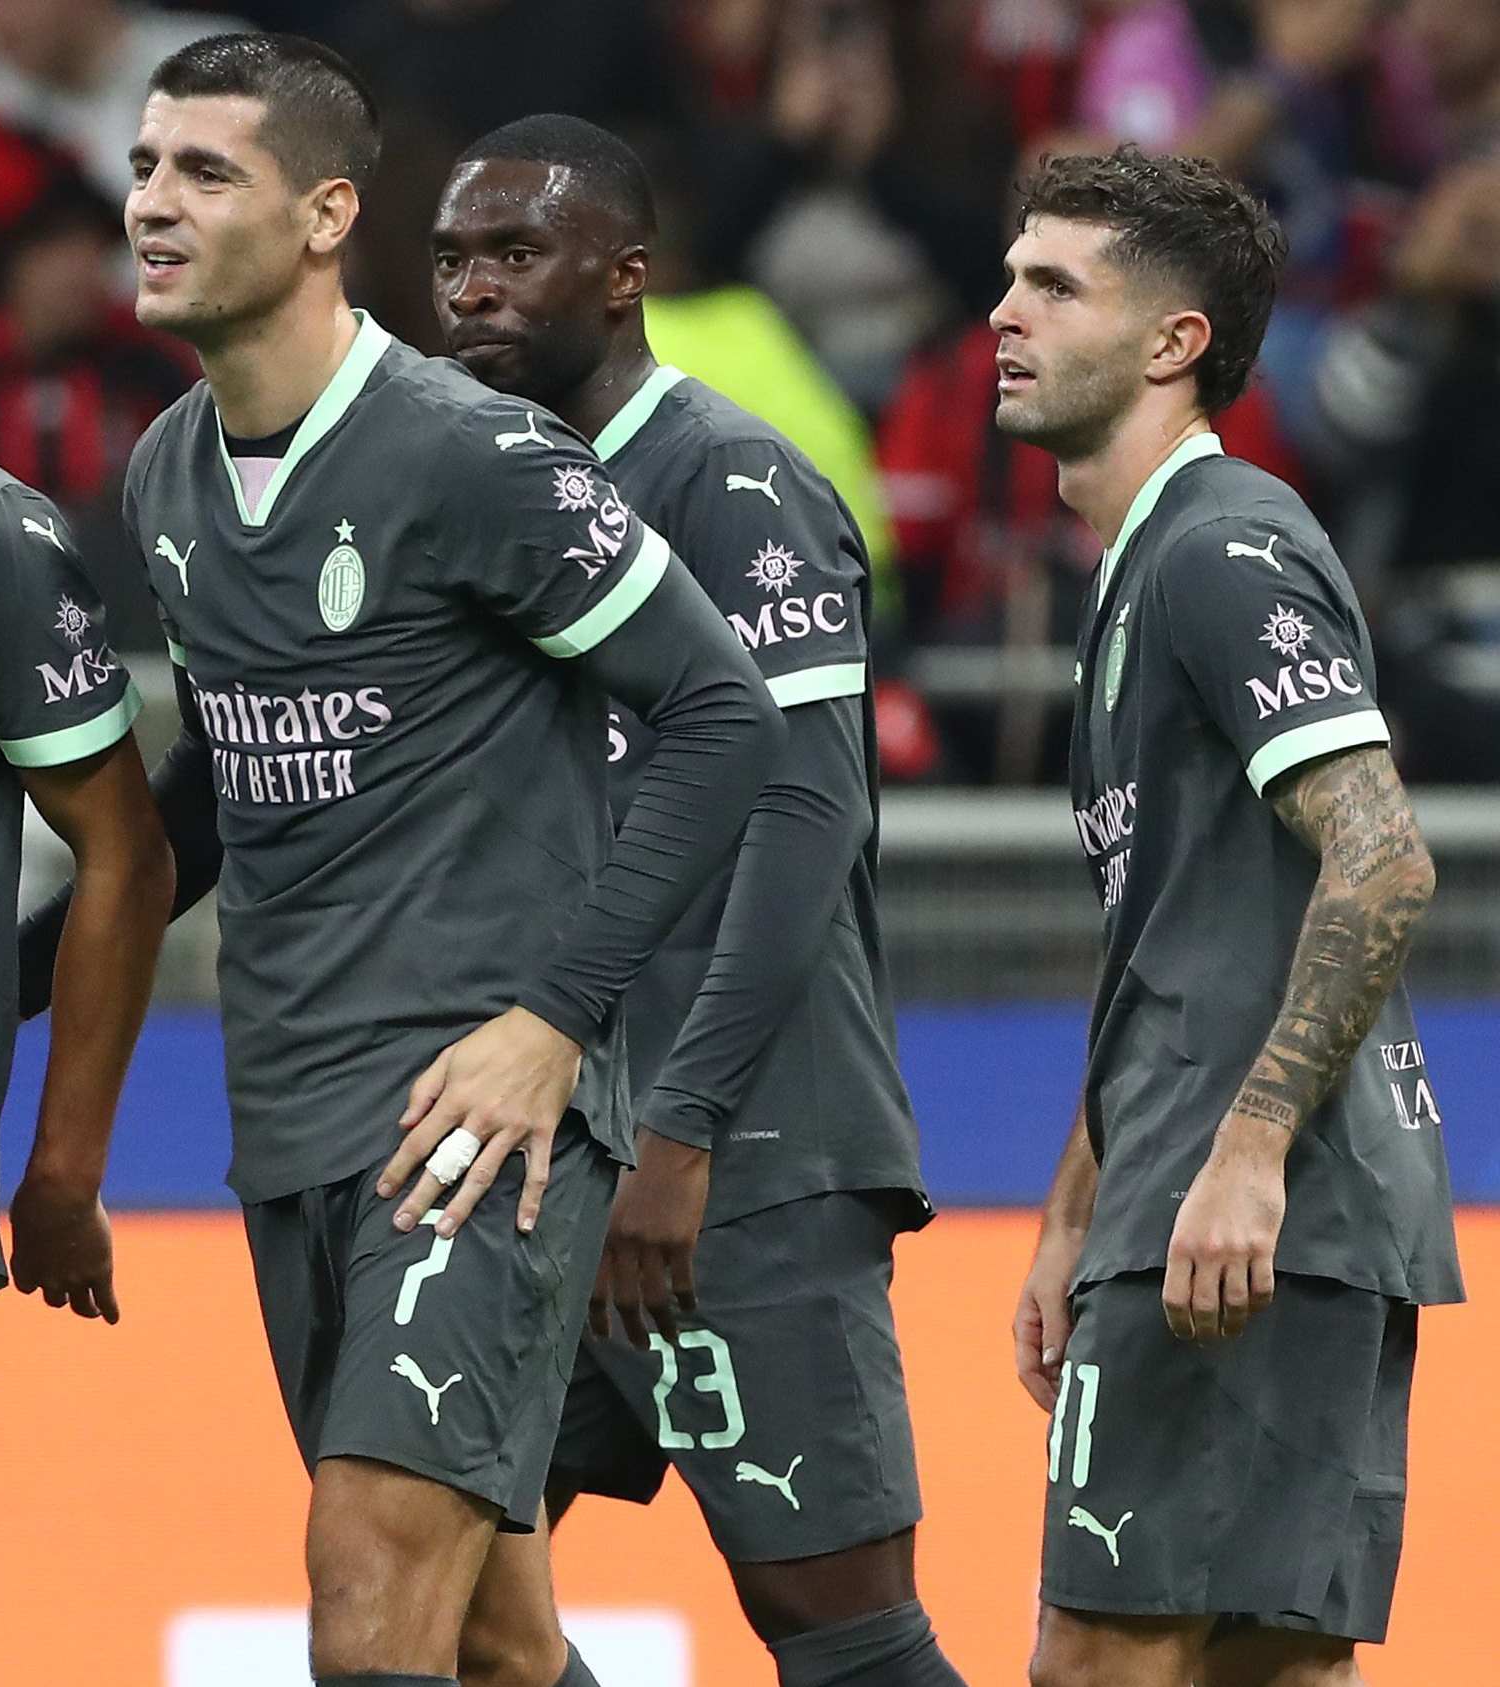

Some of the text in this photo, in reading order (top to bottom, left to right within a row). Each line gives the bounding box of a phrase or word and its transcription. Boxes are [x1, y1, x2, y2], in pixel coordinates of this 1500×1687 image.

[727, 592, 847, 651] MSC
[1244, 657, 1363, 720] MSC
[248, 748, 356, 803] BETTER
[393, 1208, 455, 1326] 7
[648, 1328, 747, 1450] 23
[1048, 1359, 1100, 1489] 11
